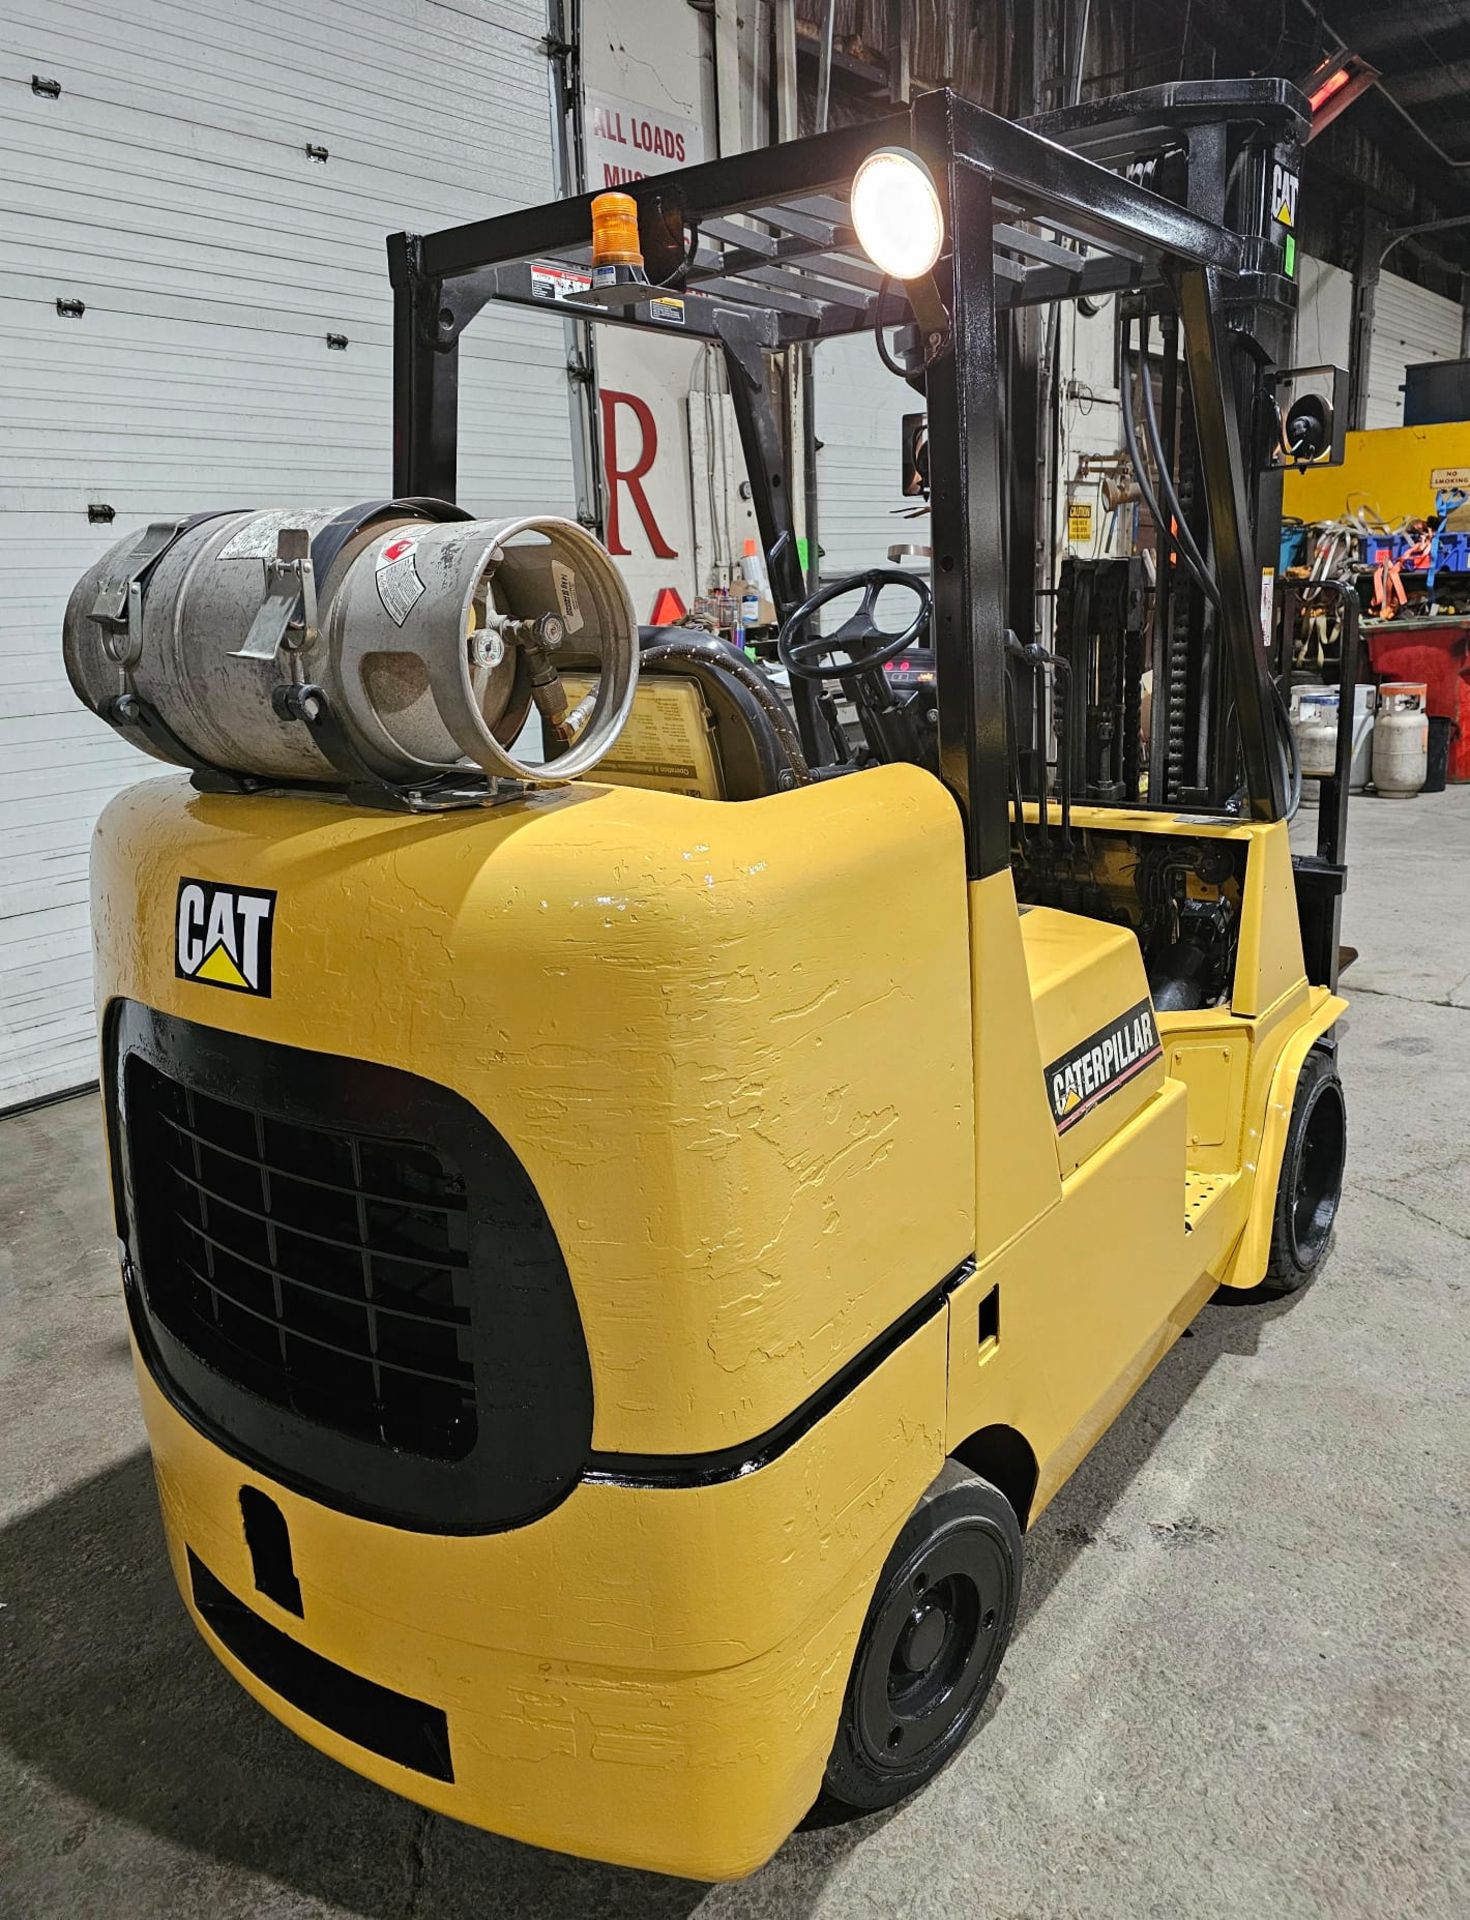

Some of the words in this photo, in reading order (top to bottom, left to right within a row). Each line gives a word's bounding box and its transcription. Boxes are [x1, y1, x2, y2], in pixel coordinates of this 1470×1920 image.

[593, 108, 627, 144] ALL
[631, 118, 686, 162] LOADS
[603, 163, 652, 188] MU
[1271, 164, 1299, 228] CAT
[178, 884, 271, 990] CAT
[1052, 1012, 1154, 1116] CATERPILLAR
